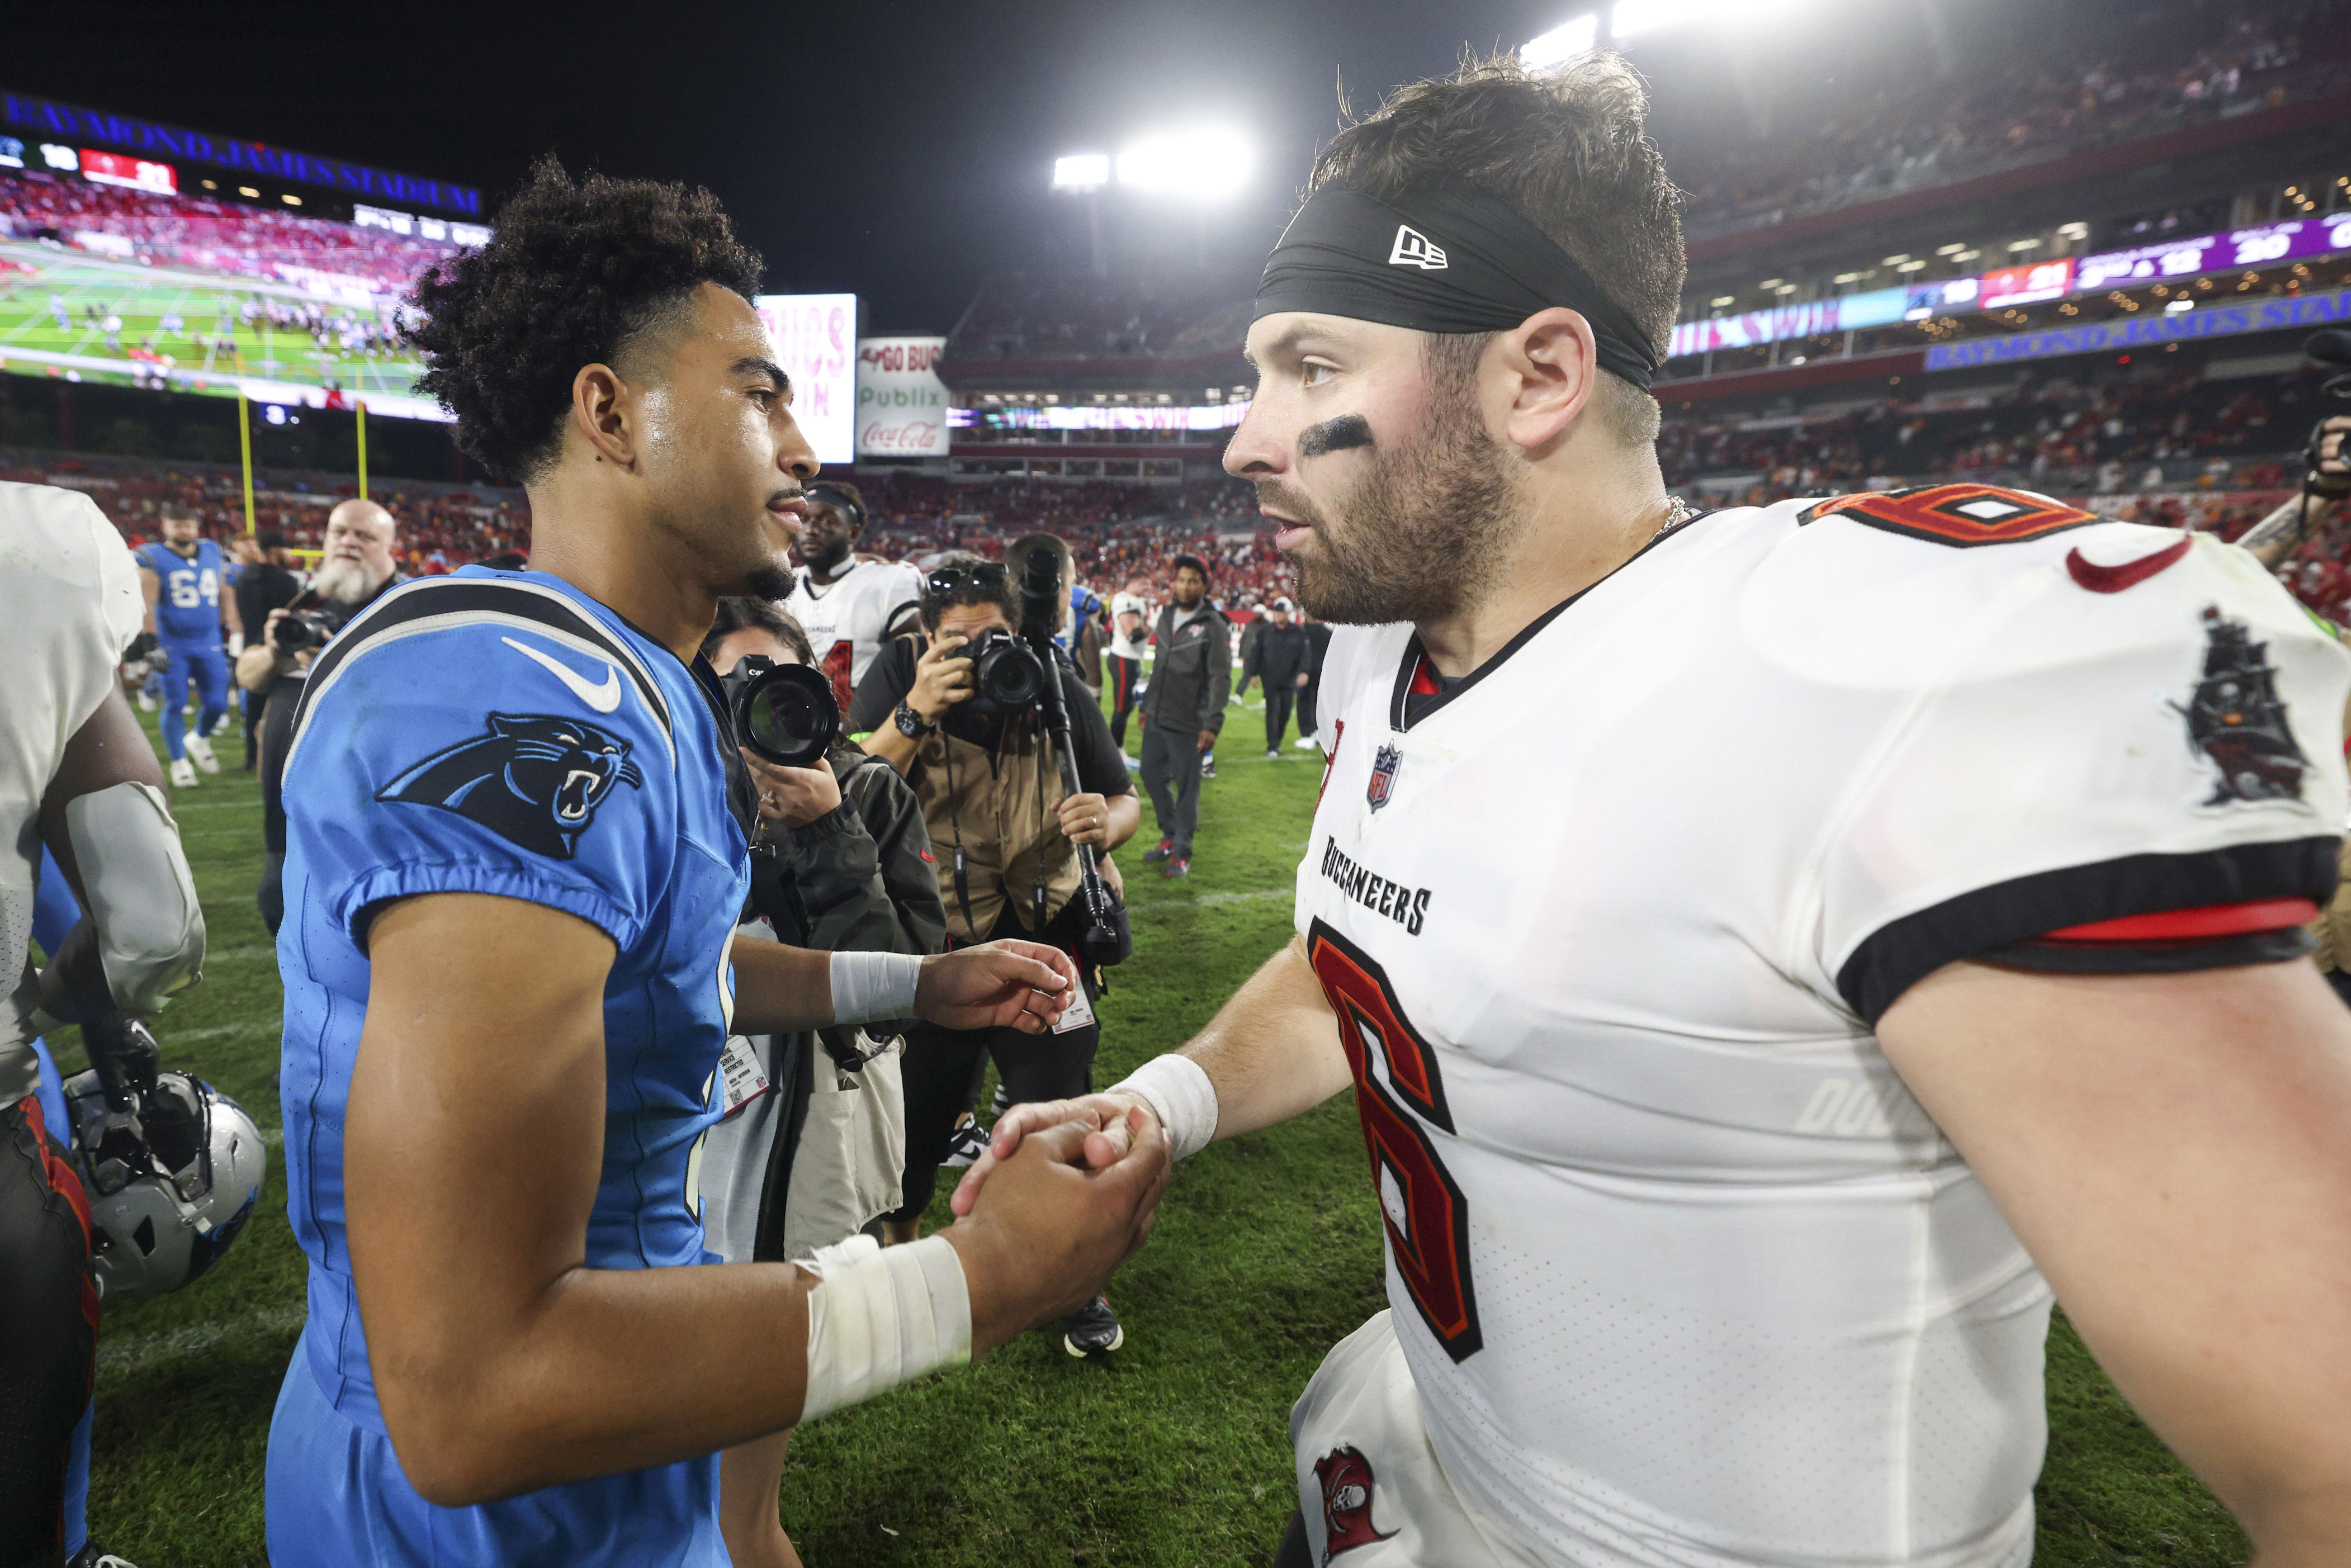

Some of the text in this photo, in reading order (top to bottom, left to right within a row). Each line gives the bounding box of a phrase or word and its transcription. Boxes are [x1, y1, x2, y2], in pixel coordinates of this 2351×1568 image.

[7, 93, 212, 162] RAYMOND
[216, 140, 337, 186] JAMES
[340, 163, 480, 215] STADIUM
[1926, 324, 2108, 371] RAYMOND
[2109, 307, 2249, 347] JAMES
[883, 346, 903, 371] GO
[859, 386, 939, 407] Publix
[169, 568, 219, 608] 64
[1369, 771, 1388, 800] NFL
[1321, 834, 1432, 937] BUCCANEERS
[720, 1054, 735, 1067] SERVICE
[723, 1059, 744, 1074] RESTRICTED
